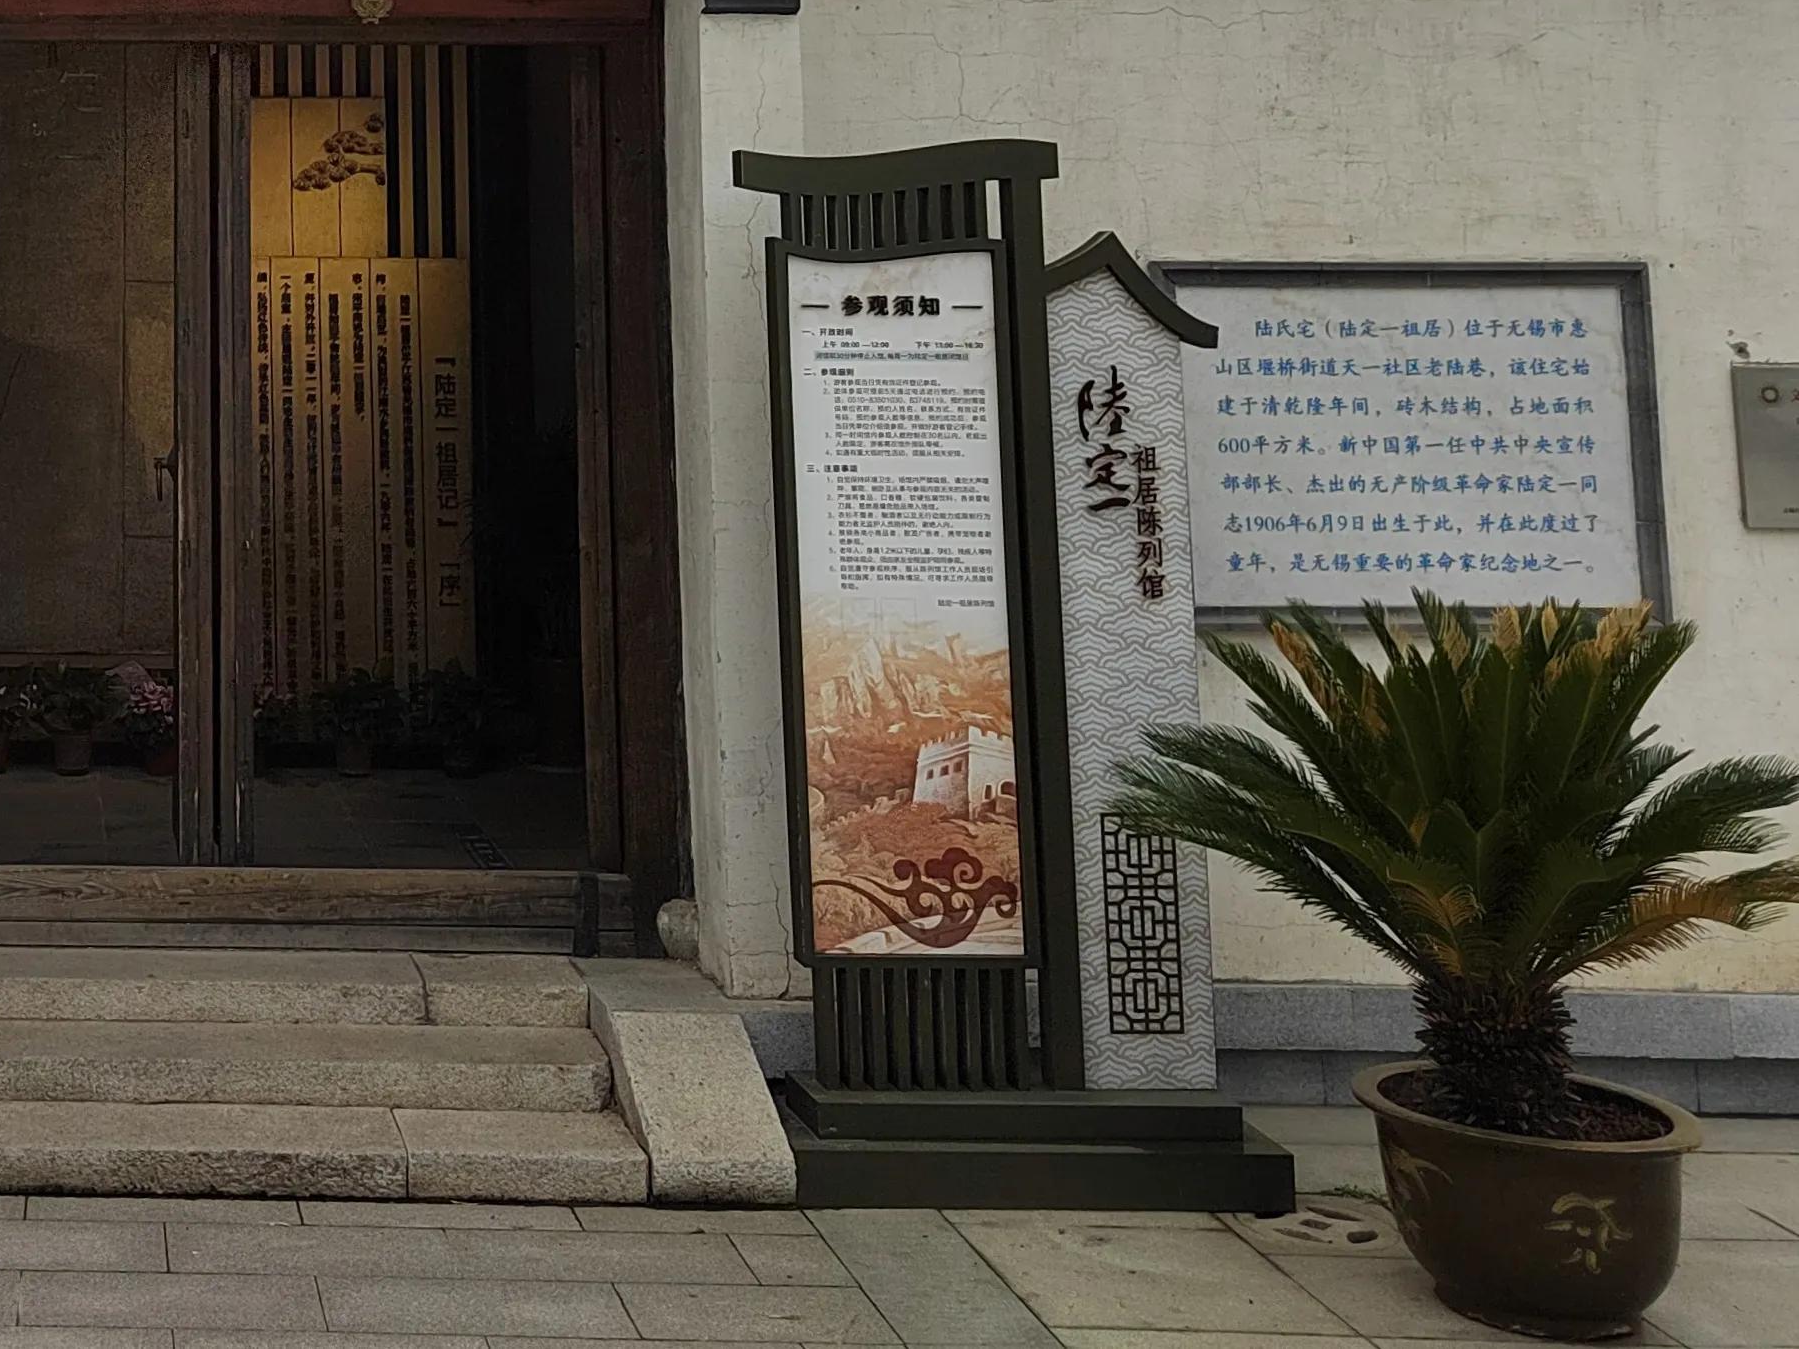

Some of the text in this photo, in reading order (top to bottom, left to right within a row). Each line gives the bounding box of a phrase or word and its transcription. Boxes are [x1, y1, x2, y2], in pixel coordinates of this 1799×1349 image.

[841, 295, 941, 316] 参观须知
[1215, 358, 1591, 377] 山区堰桥街道天一社区老陆巷，该住宅始
[1217, 395, 1594, 416] 建于清乾隆年间，砖木结构，占地面积
[1217, 435, 1595, 456] 600平方米。新中国第一任中共中央宣传
[1220, 474, 1598, 494] 部部长、杰出的无产阶级革命家陆定一同
[1132, 444, 1165, 598] 祖居陈列馆
[1224, 513, 1599, 533] 志1906年6月9日出生于此，并在此度过了
[1225, 553, 1595, 574] 童年，是无锡重要的革命家纪念地之一。
